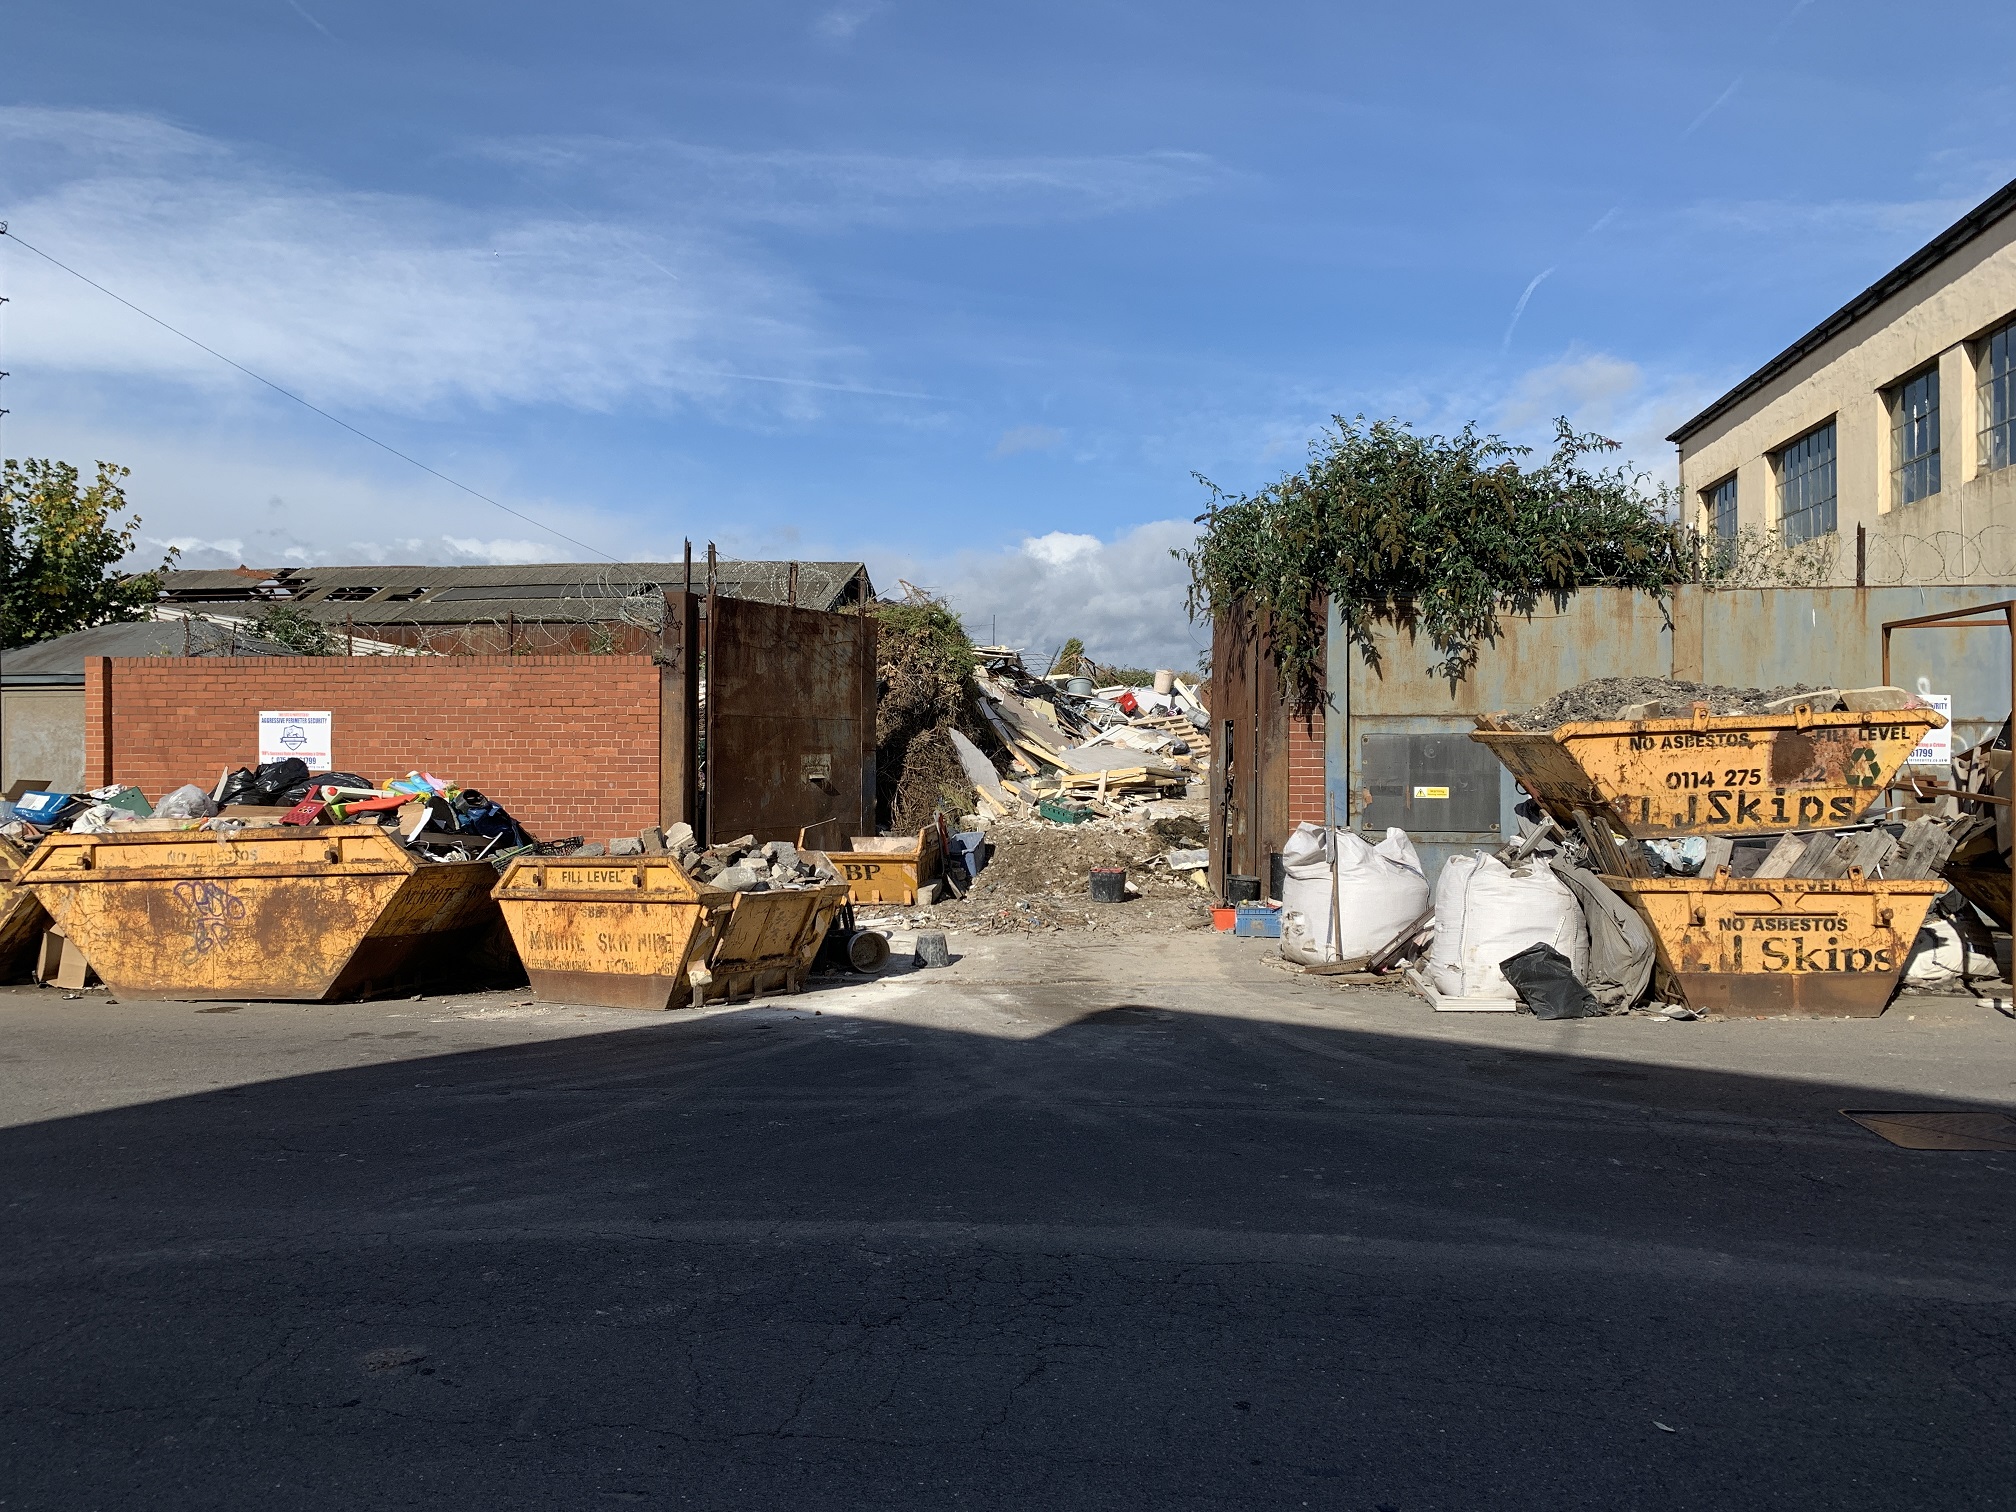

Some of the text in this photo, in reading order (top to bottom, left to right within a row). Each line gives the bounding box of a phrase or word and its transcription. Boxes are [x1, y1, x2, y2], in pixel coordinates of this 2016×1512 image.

[1858, 726, 1910, 741] LEVEL
[1629, 733, 1751, 750] NO ASBESTOS
[1910, 749, 1933, 758] 61799
[1665, 771, 1715, 789] 0114
[1724, 769, 1762, 787] 275
[167, 850, 187, 863] NO
[562, 870, 623, 884] FILL LEVEL
[843, 864, 881, 881] BP
[1718, 917, 1848, 932] NO ASBESTOS
[1762, 936, 1894, 973] Skips
